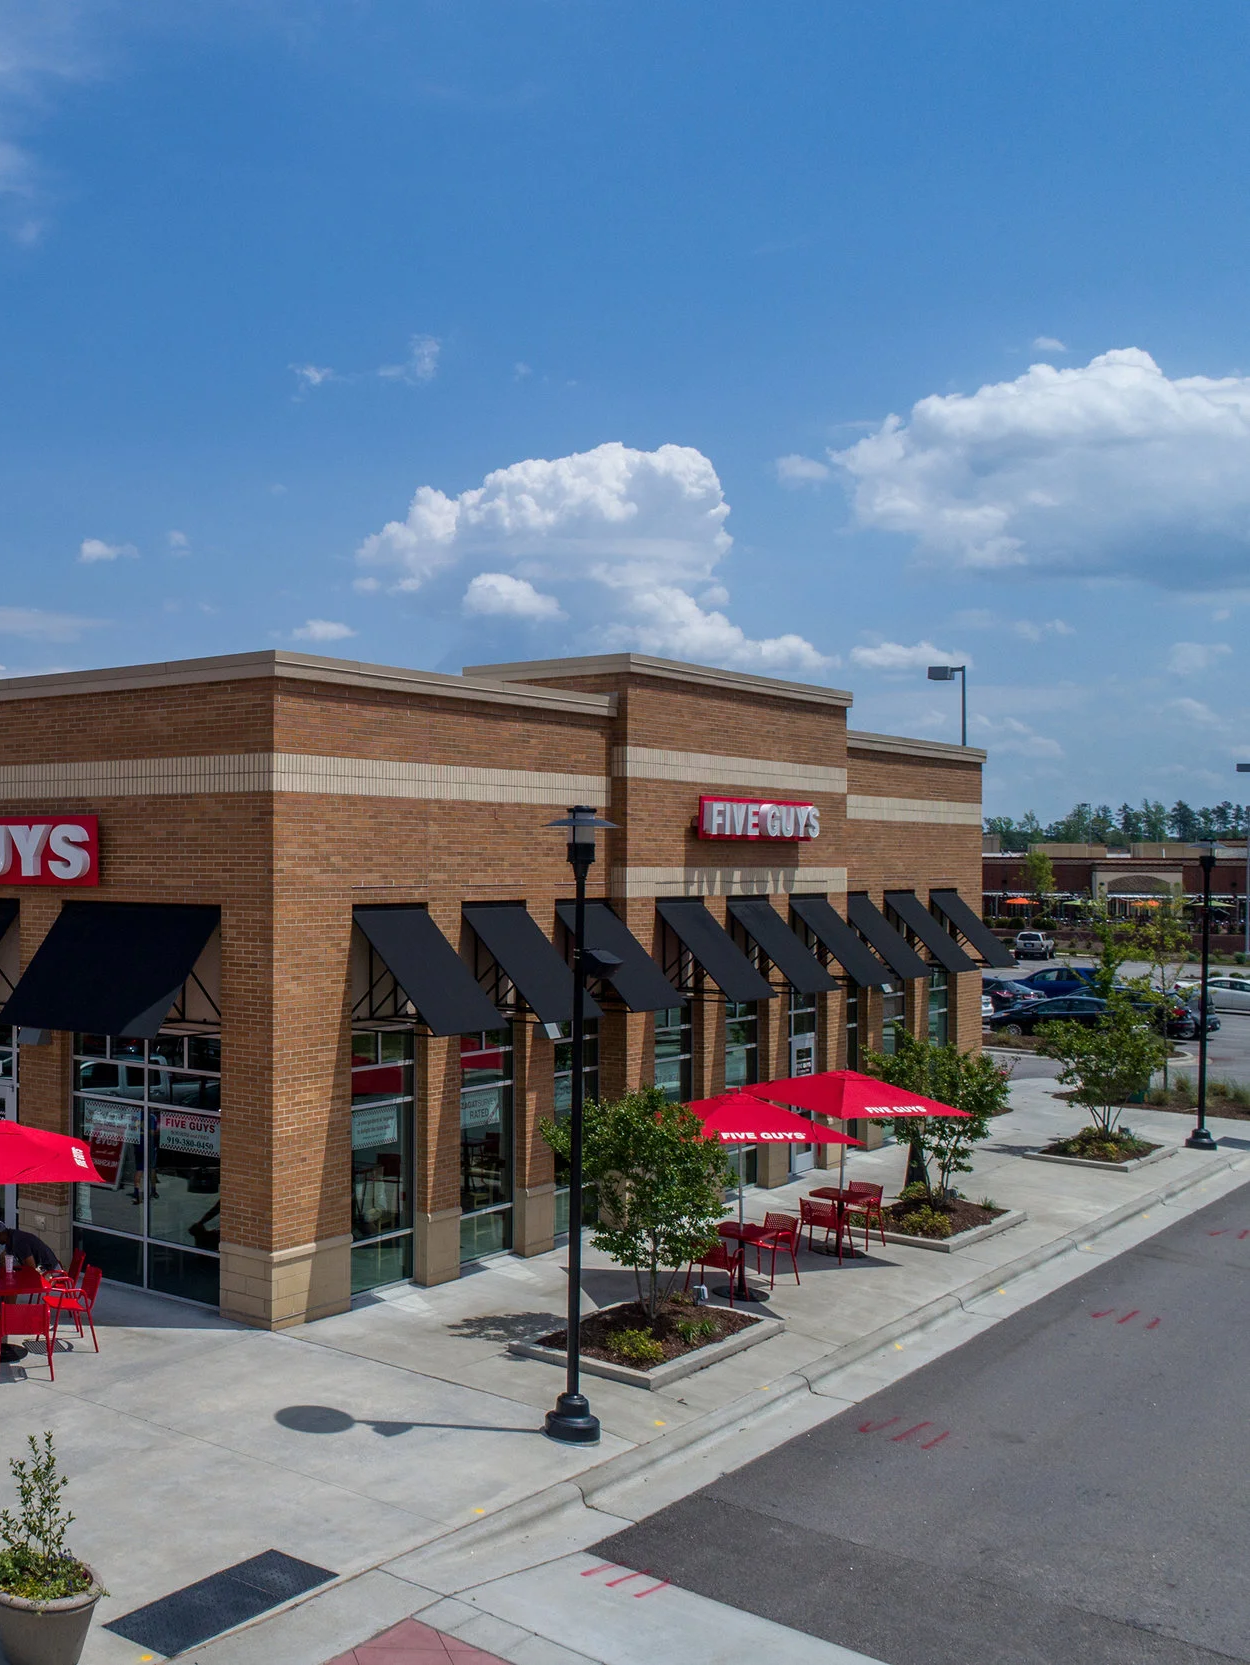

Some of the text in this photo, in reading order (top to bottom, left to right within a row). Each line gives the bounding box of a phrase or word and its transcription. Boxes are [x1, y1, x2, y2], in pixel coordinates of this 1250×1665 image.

[705, 801, 820, 839] FIVE GUYS
[470, 1108, 489, 1119] RATED
[865, 1105, 927, 1114] FIVE GUYS
[165, 1118, 215, 1134] FIVE GUYS
[166, 1135, 214, 1150] 919-380-0450
[721, 1131, 806, 1141] FIVE GUYS
